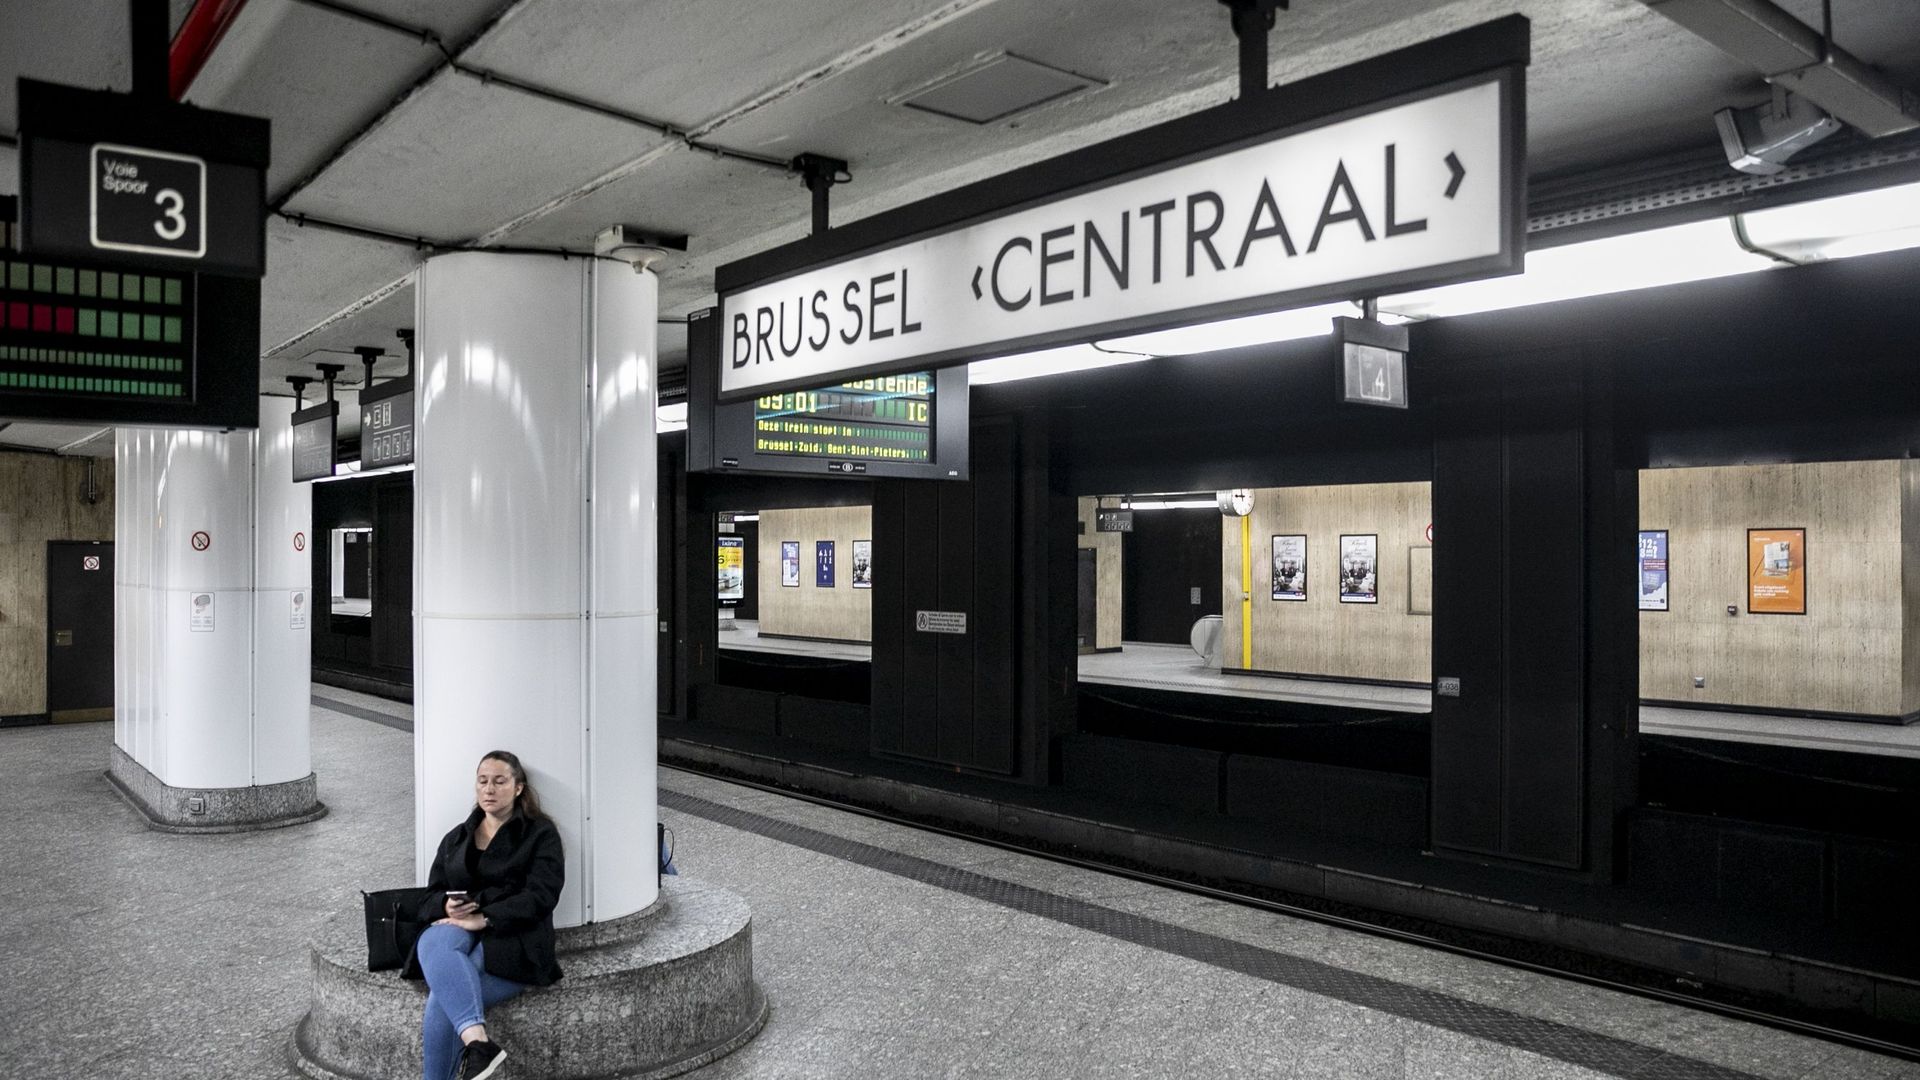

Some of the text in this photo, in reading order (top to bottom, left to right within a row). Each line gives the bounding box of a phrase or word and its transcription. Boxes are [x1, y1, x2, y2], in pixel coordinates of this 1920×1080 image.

[103, 159, 138, 178] Voie
[103, 174, 149, 194] Spoor
[153, 187, 187, 241] 3
[732, 143, 1429, 371] BRUSSEL CENTRAAL
[1374, 367, 1385, 393] 4
[908, 402, 927, 422] IC
[758, 420, 780, 432] Deze
[784, 421, 809, 434] trein
[813, 424, 837, 436] stopt
[842, 426, 853, 437] in
